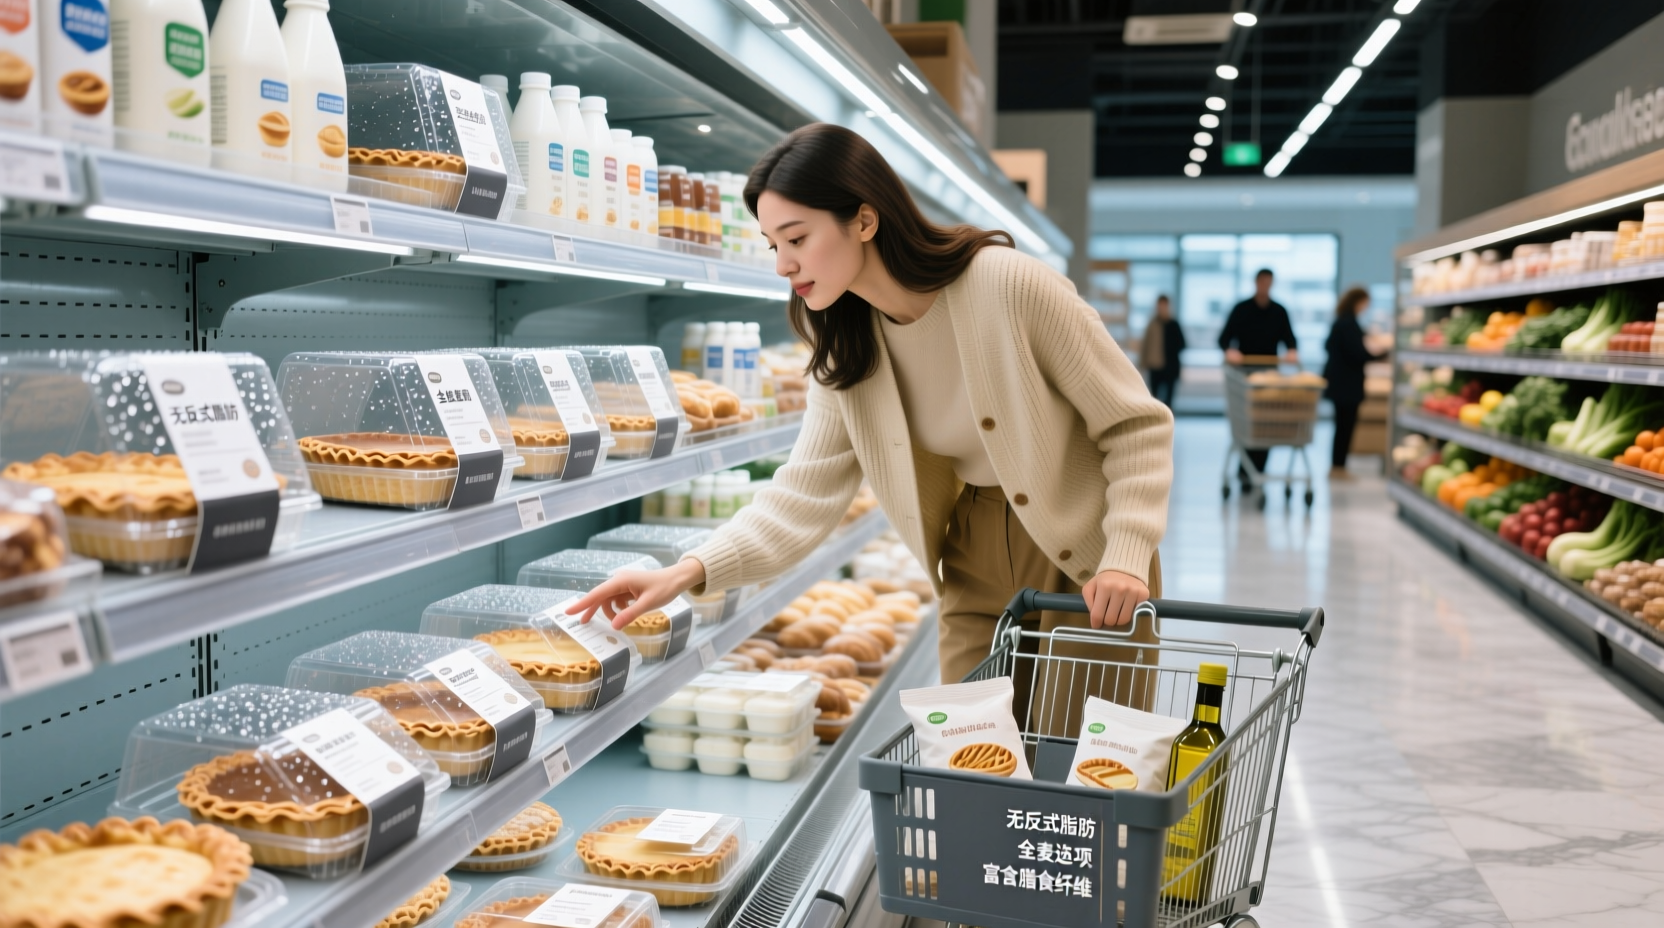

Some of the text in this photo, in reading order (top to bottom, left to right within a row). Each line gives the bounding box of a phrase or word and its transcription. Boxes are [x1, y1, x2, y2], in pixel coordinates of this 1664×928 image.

[1006, 809, 1096, 838] 无反式脂肪
